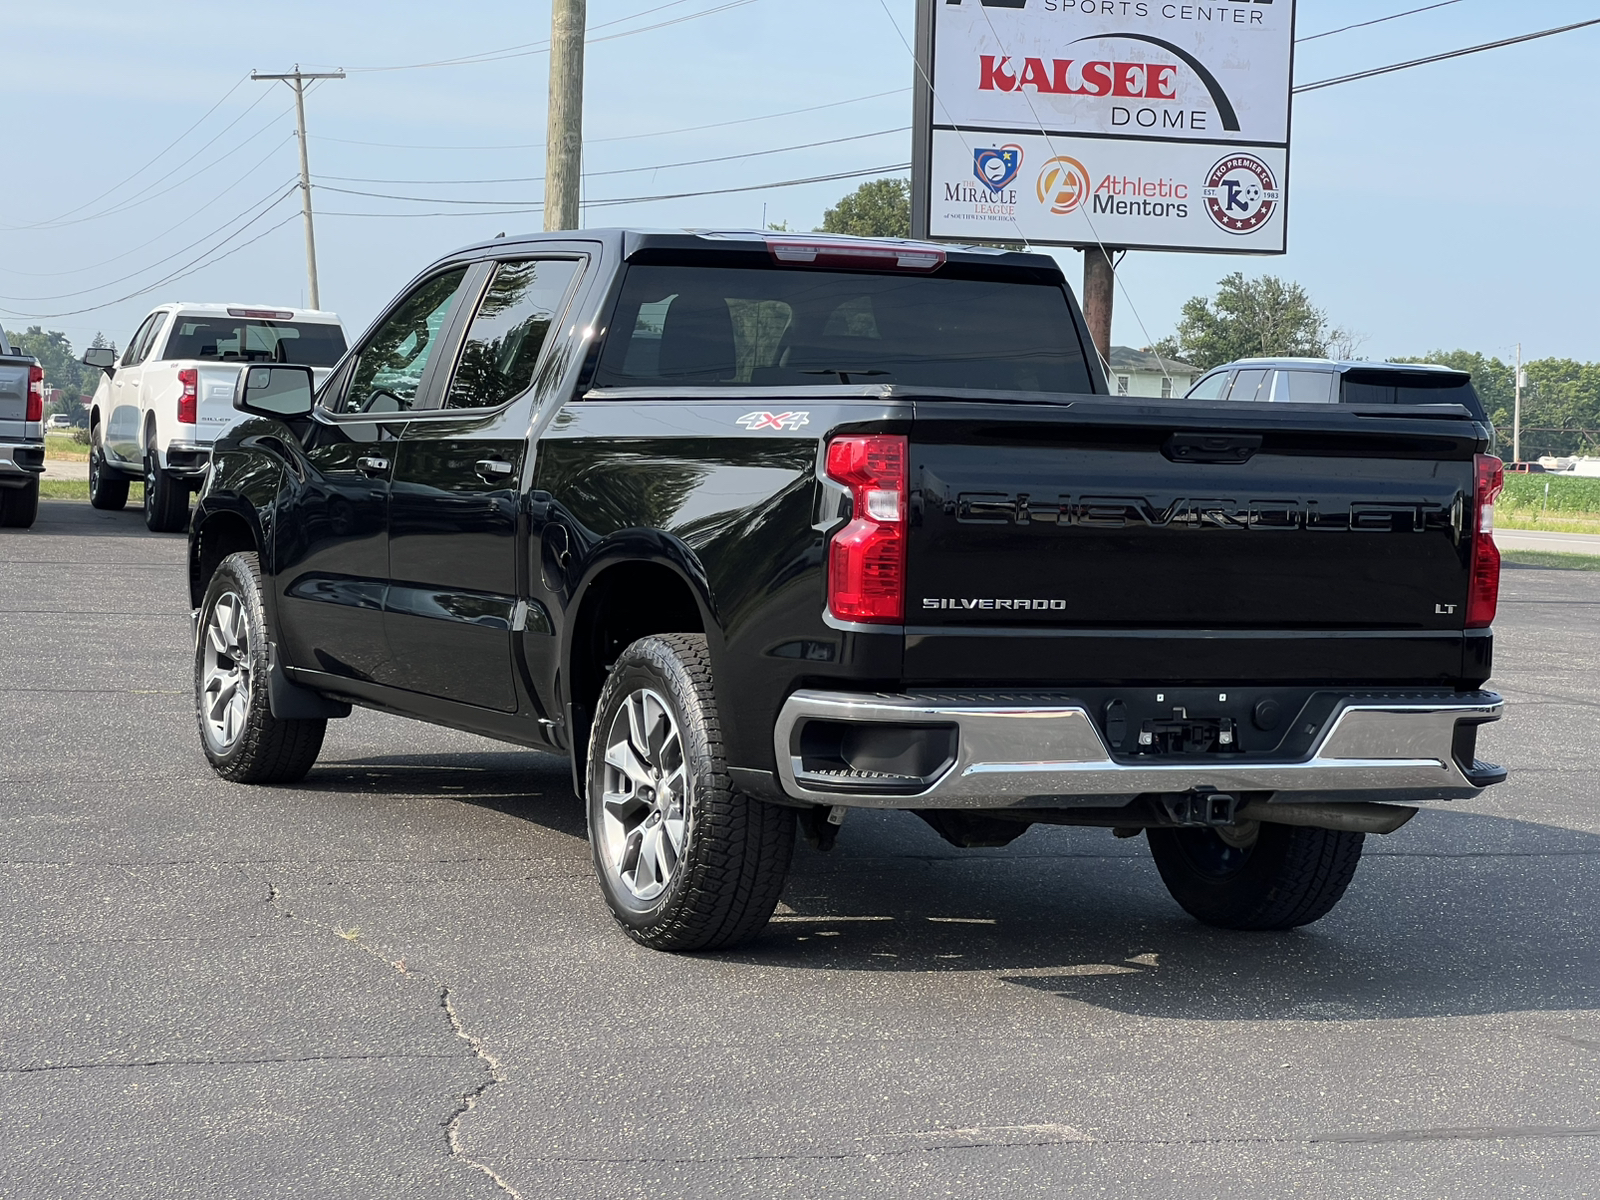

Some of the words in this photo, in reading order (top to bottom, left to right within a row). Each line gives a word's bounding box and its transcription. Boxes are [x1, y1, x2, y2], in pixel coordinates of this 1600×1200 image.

[1045, 0, 1148, 17] SPORTS
[1161, 5, 1264, 25] CENTER
[978, 55, 1177, 100] KALSEE
[1111, 106, 1207, 130] DOME
[1213, 165, 1226, 181] TKO
[1227, 159, 1262, 174] PREMIER
[1260, 172, 1270, 184] SC
[944, 182, 1017, 205] MIRACLE
[1094, 174, 1188, 199] Athletic
[951, 213, 986, 221] SOUTHWEST
[975, 204, 1014, 215] LEAGUE
[1093, 194, 1188, 218] Mentors
[956, 491, 1443, 532] CHEVROLET
[922, 598, 1066, 610] SILVERADO
[1435, 603, 1457, 614] LT
